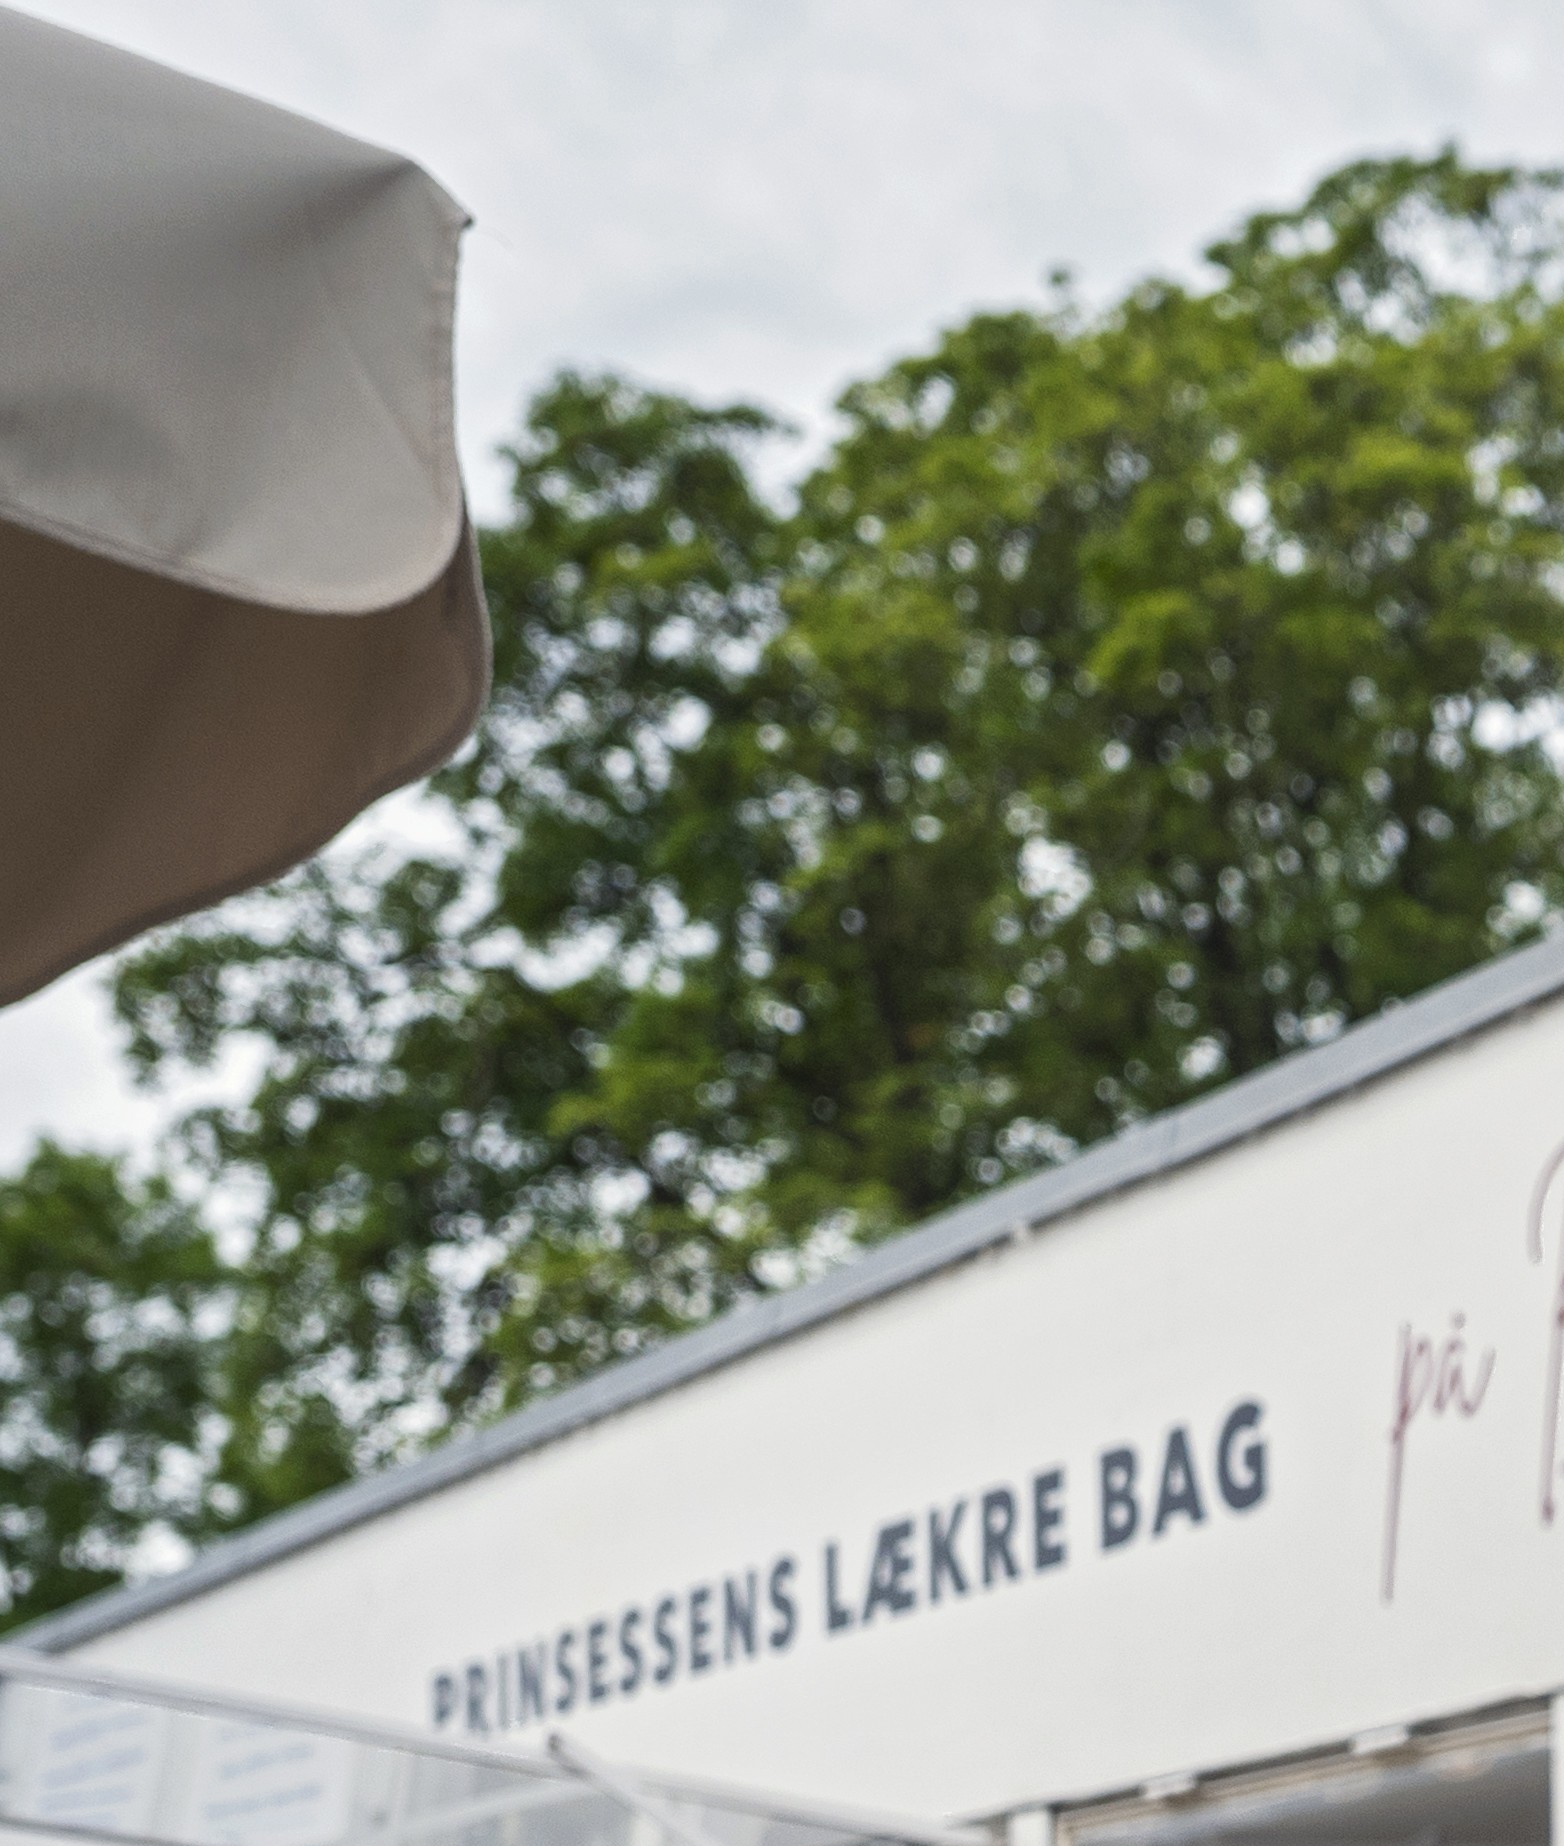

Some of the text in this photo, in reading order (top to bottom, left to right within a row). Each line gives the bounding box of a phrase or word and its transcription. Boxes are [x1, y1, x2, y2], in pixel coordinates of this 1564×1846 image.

[433, 1399, 1266, 1732] PRINSESSENS LÆKRE BAG
[1381, 1312, 1497, 1602] på
